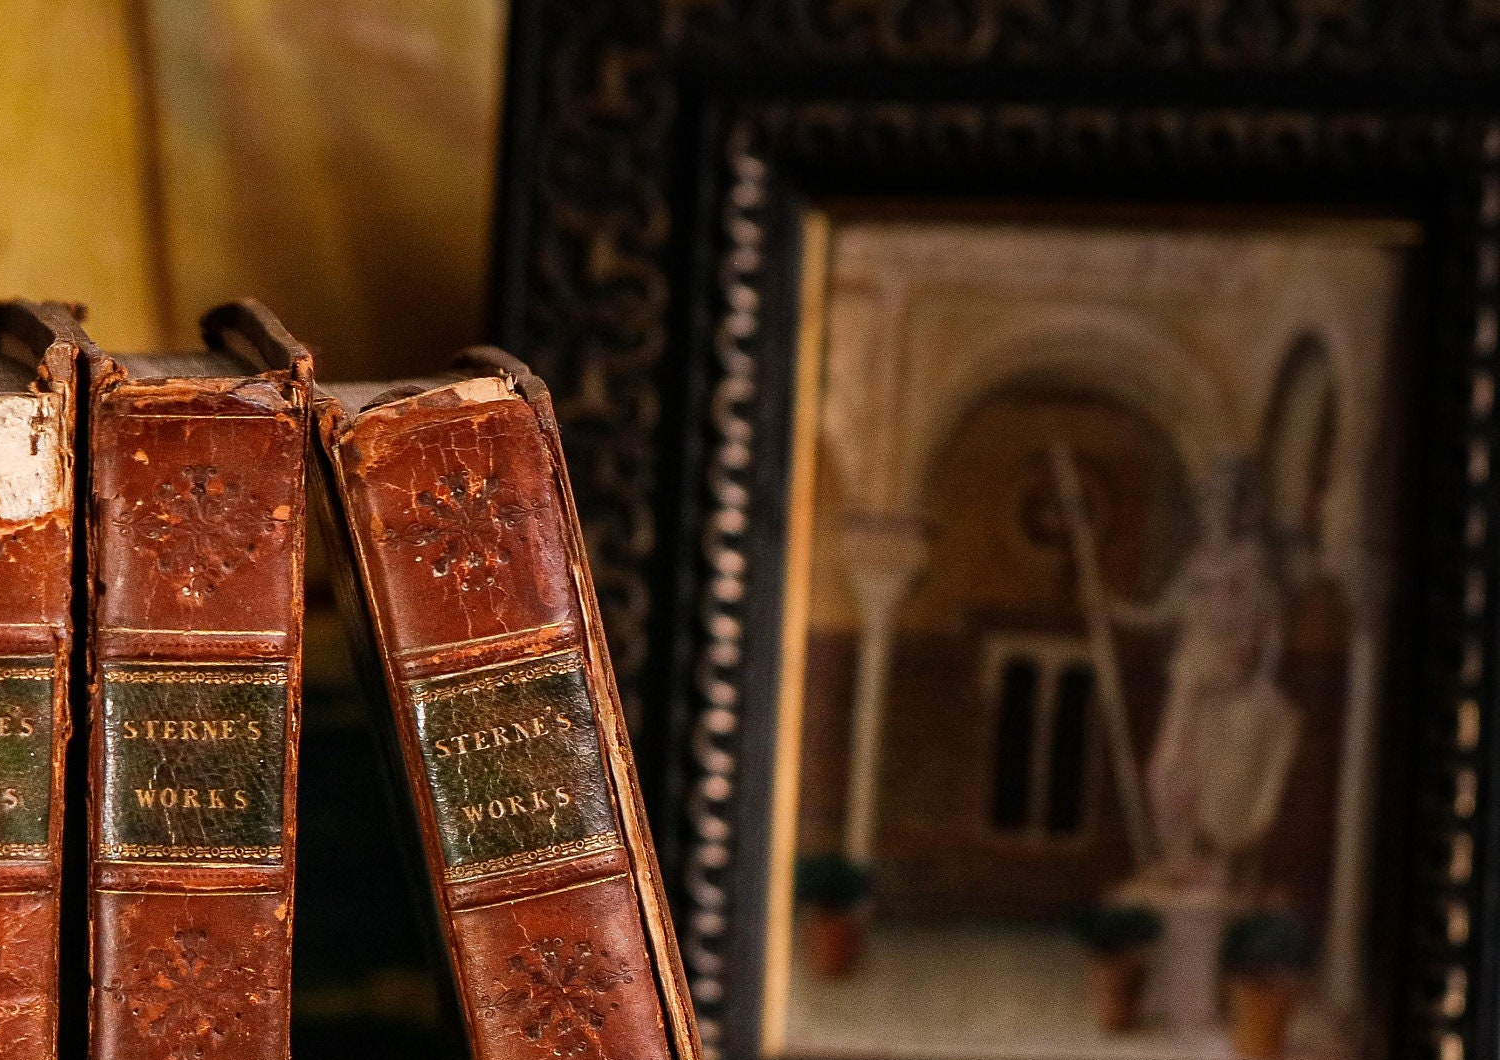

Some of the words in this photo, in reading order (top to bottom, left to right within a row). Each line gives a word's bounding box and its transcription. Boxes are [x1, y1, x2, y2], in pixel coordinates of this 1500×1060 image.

[122, 712, 262, 741] STERNE'S
[434, 705, 573, 758] STERNE'S
[134, 787, 249, 810] WORKS
[461, 786, 574, 823] WORKS
